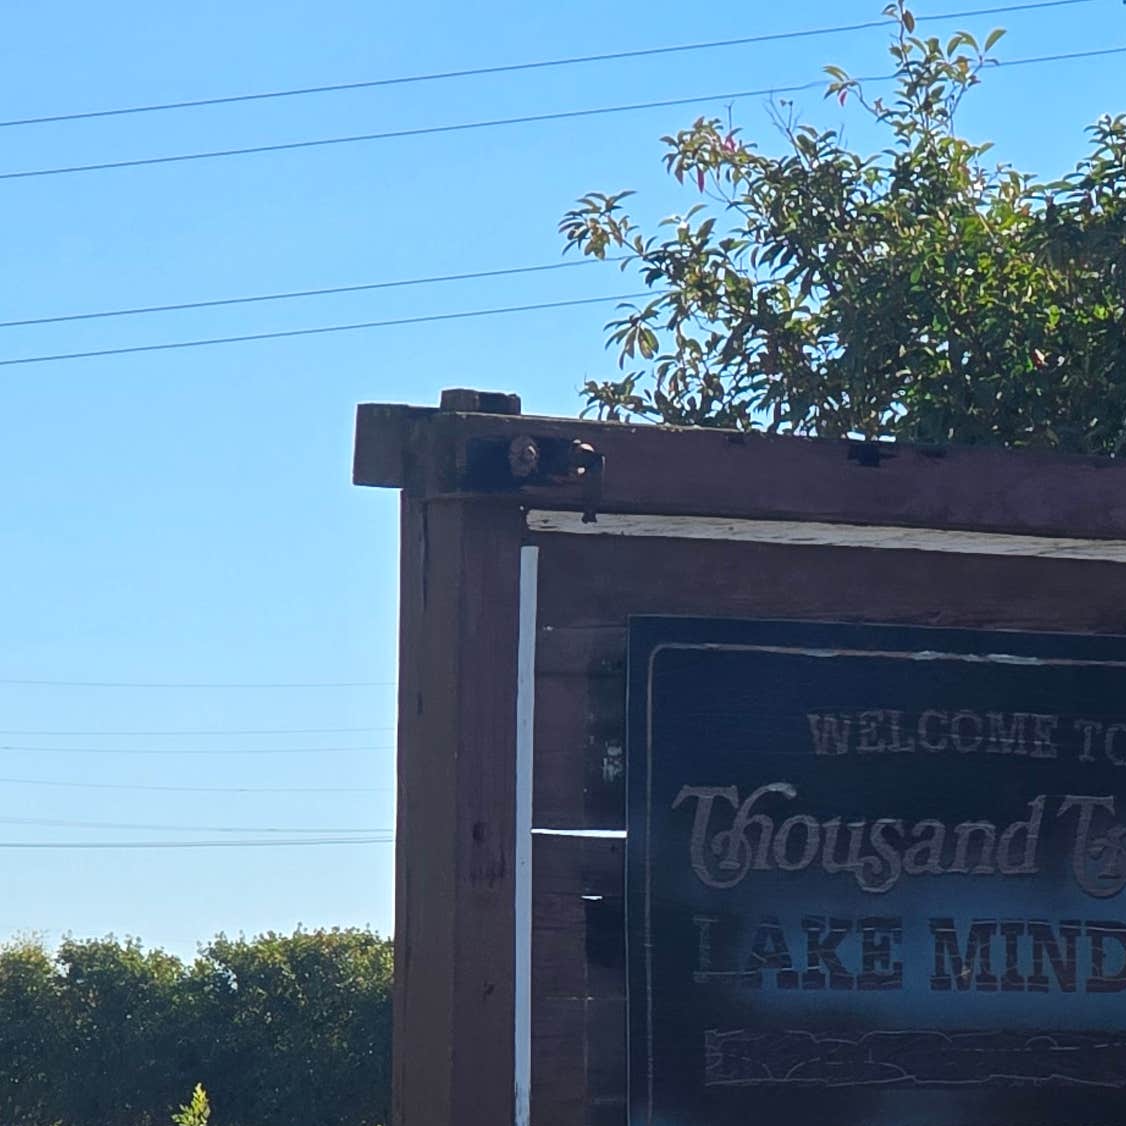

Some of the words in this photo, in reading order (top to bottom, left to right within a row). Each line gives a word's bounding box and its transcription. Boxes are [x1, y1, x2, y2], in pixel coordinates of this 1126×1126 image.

[807, 708, 1061, 758] WELCOME
[672, 782, 1050, 894] Thousand
[693, 914, 904, 992] LAKE
